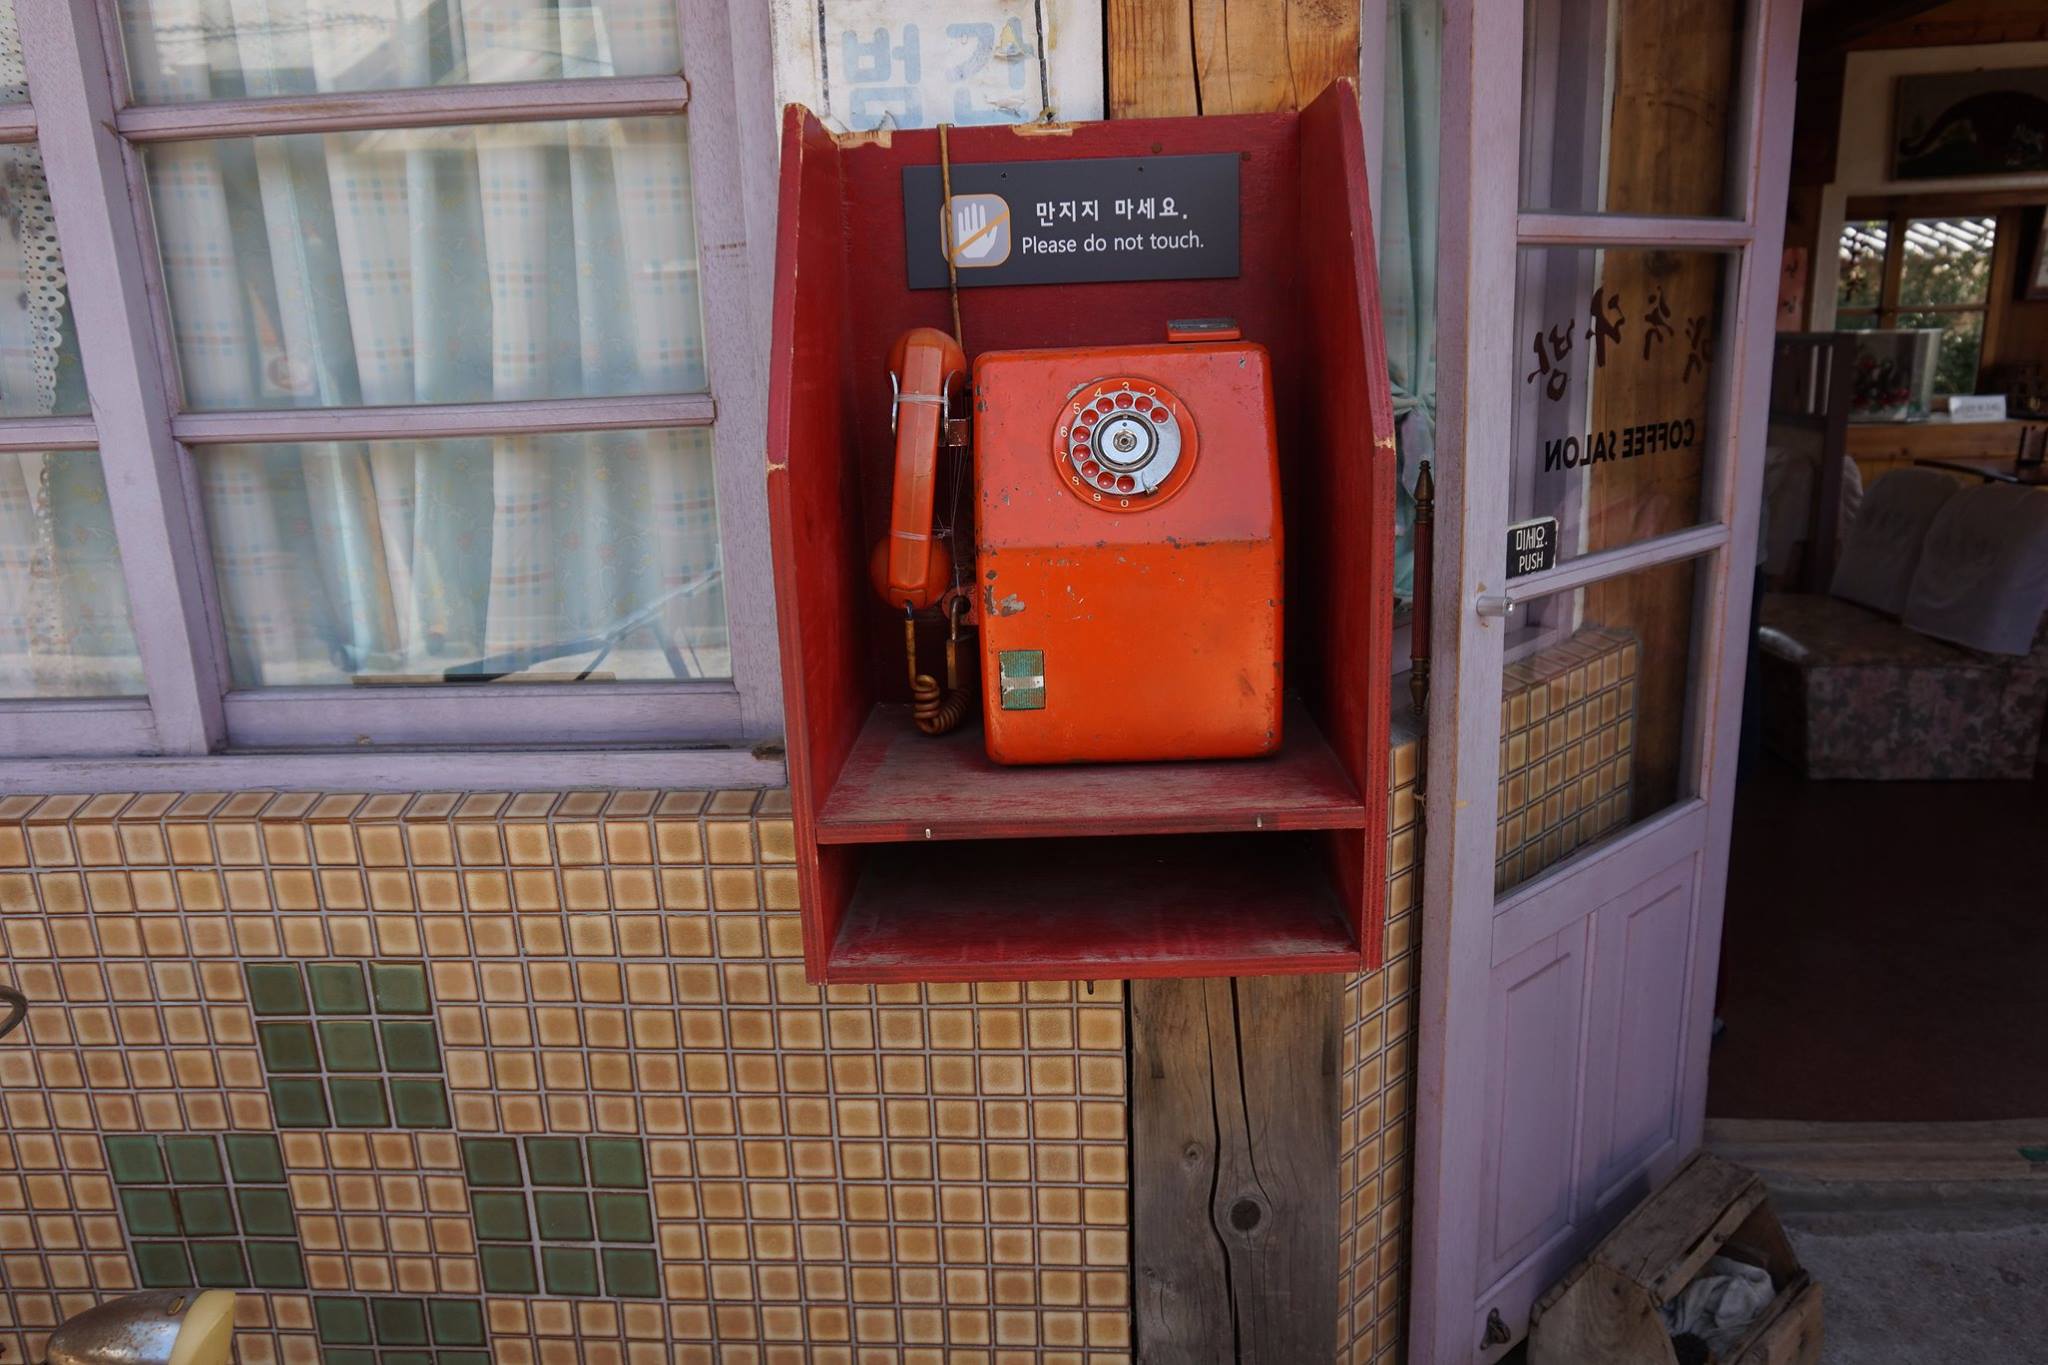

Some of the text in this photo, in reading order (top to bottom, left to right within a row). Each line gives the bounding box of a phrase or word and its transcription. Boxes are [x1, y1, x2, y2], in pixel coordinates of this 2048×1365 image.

[1035, 196, 1188, 227] 만지지 마세요.
[1021, 229, 1205, 255] Please do not touch.
[1094, 387, 1102, 397] 4
[1121, 381, 1130, 392] 3
[1148, 386, 1157, 396] 2
[1073, 402, 1081, 415] 5
[1172, 402, 1177, 415] 1
[1060, 426, 1068, 437] 6
[1059, 451, 1068, 463] 7
[1072, 475, 1080, 486] 8
[1093, 492, 1101, 501] 9
[1120, 499, 1129, 507] 0
[1515, 526, 1548, 551] 미세요.
[1519, 551, 1544, 573] PUSH
